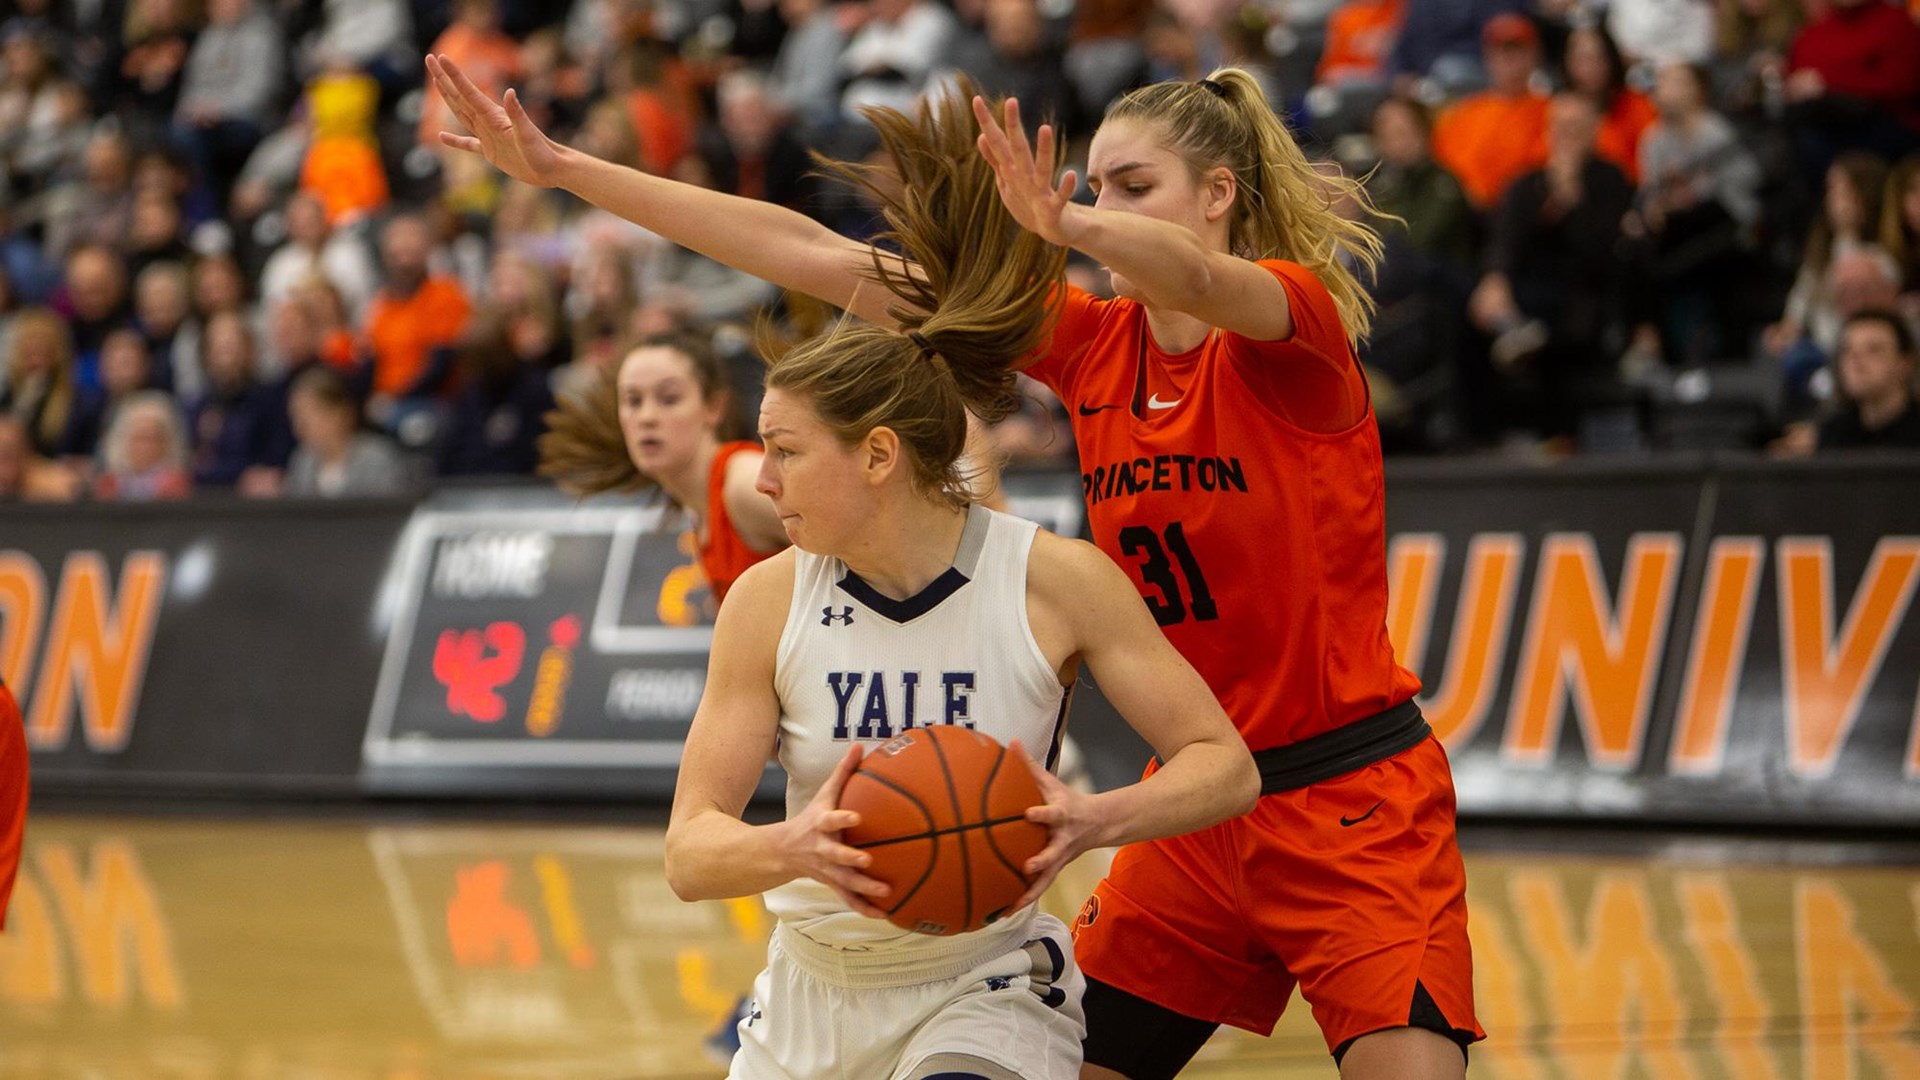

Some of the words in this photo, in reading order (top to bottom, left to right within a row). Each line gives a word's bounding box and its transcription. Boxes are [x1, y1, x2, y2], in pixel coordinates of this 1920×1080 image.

[1083, 454, 1249, 505] PRINCETON
[1118, 521, 1219, 627] 31
[1380, 532, 1920, 778] UNIV
[826, 670, 977, 741] YALE
